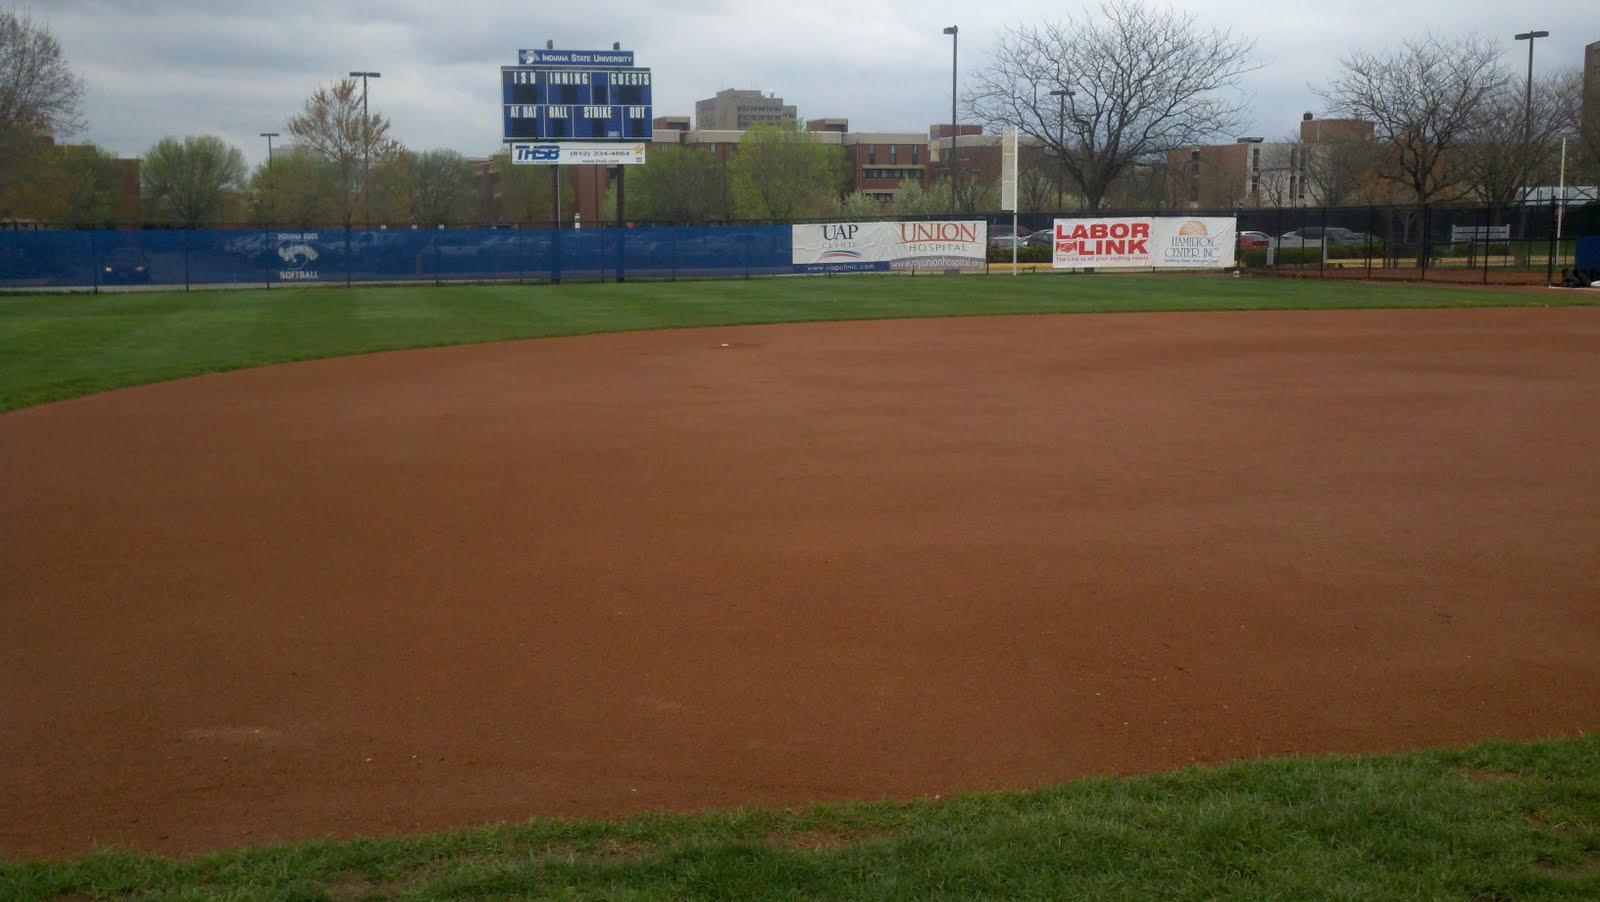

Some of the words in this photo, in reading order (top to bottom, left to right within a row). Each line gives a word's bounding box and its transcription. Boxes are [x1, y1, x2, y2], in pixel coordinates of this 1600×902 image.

[571, 54, 591, 62] STATE
[594, 54, 632, 62] UNIVERSITY
[550, 73, 588, 84] INNING
[611, 74, 650, 85] GUESTS
[510, 106, 519, 118] AT
[523, 106, 537, 118] BAT
[550, 106, 568, 118] BALL
[584, 107, 612, 118] STRIKE
[630, 107, 646, 118] OUT
[516, 146, 560, 160] THSB
[822, 224, 858, 240] UAP
[901, 223, 976, 242] UNION
[1056, 223, 1149, 240] LABOR
[909, 244, 967, 252] HOSPITAL
[1079, 240, 1149, 255] LINK
[1171, 237, 1214, 247] HAMILTON
[890, 257, 984, 270] www.myunionhospital.org
